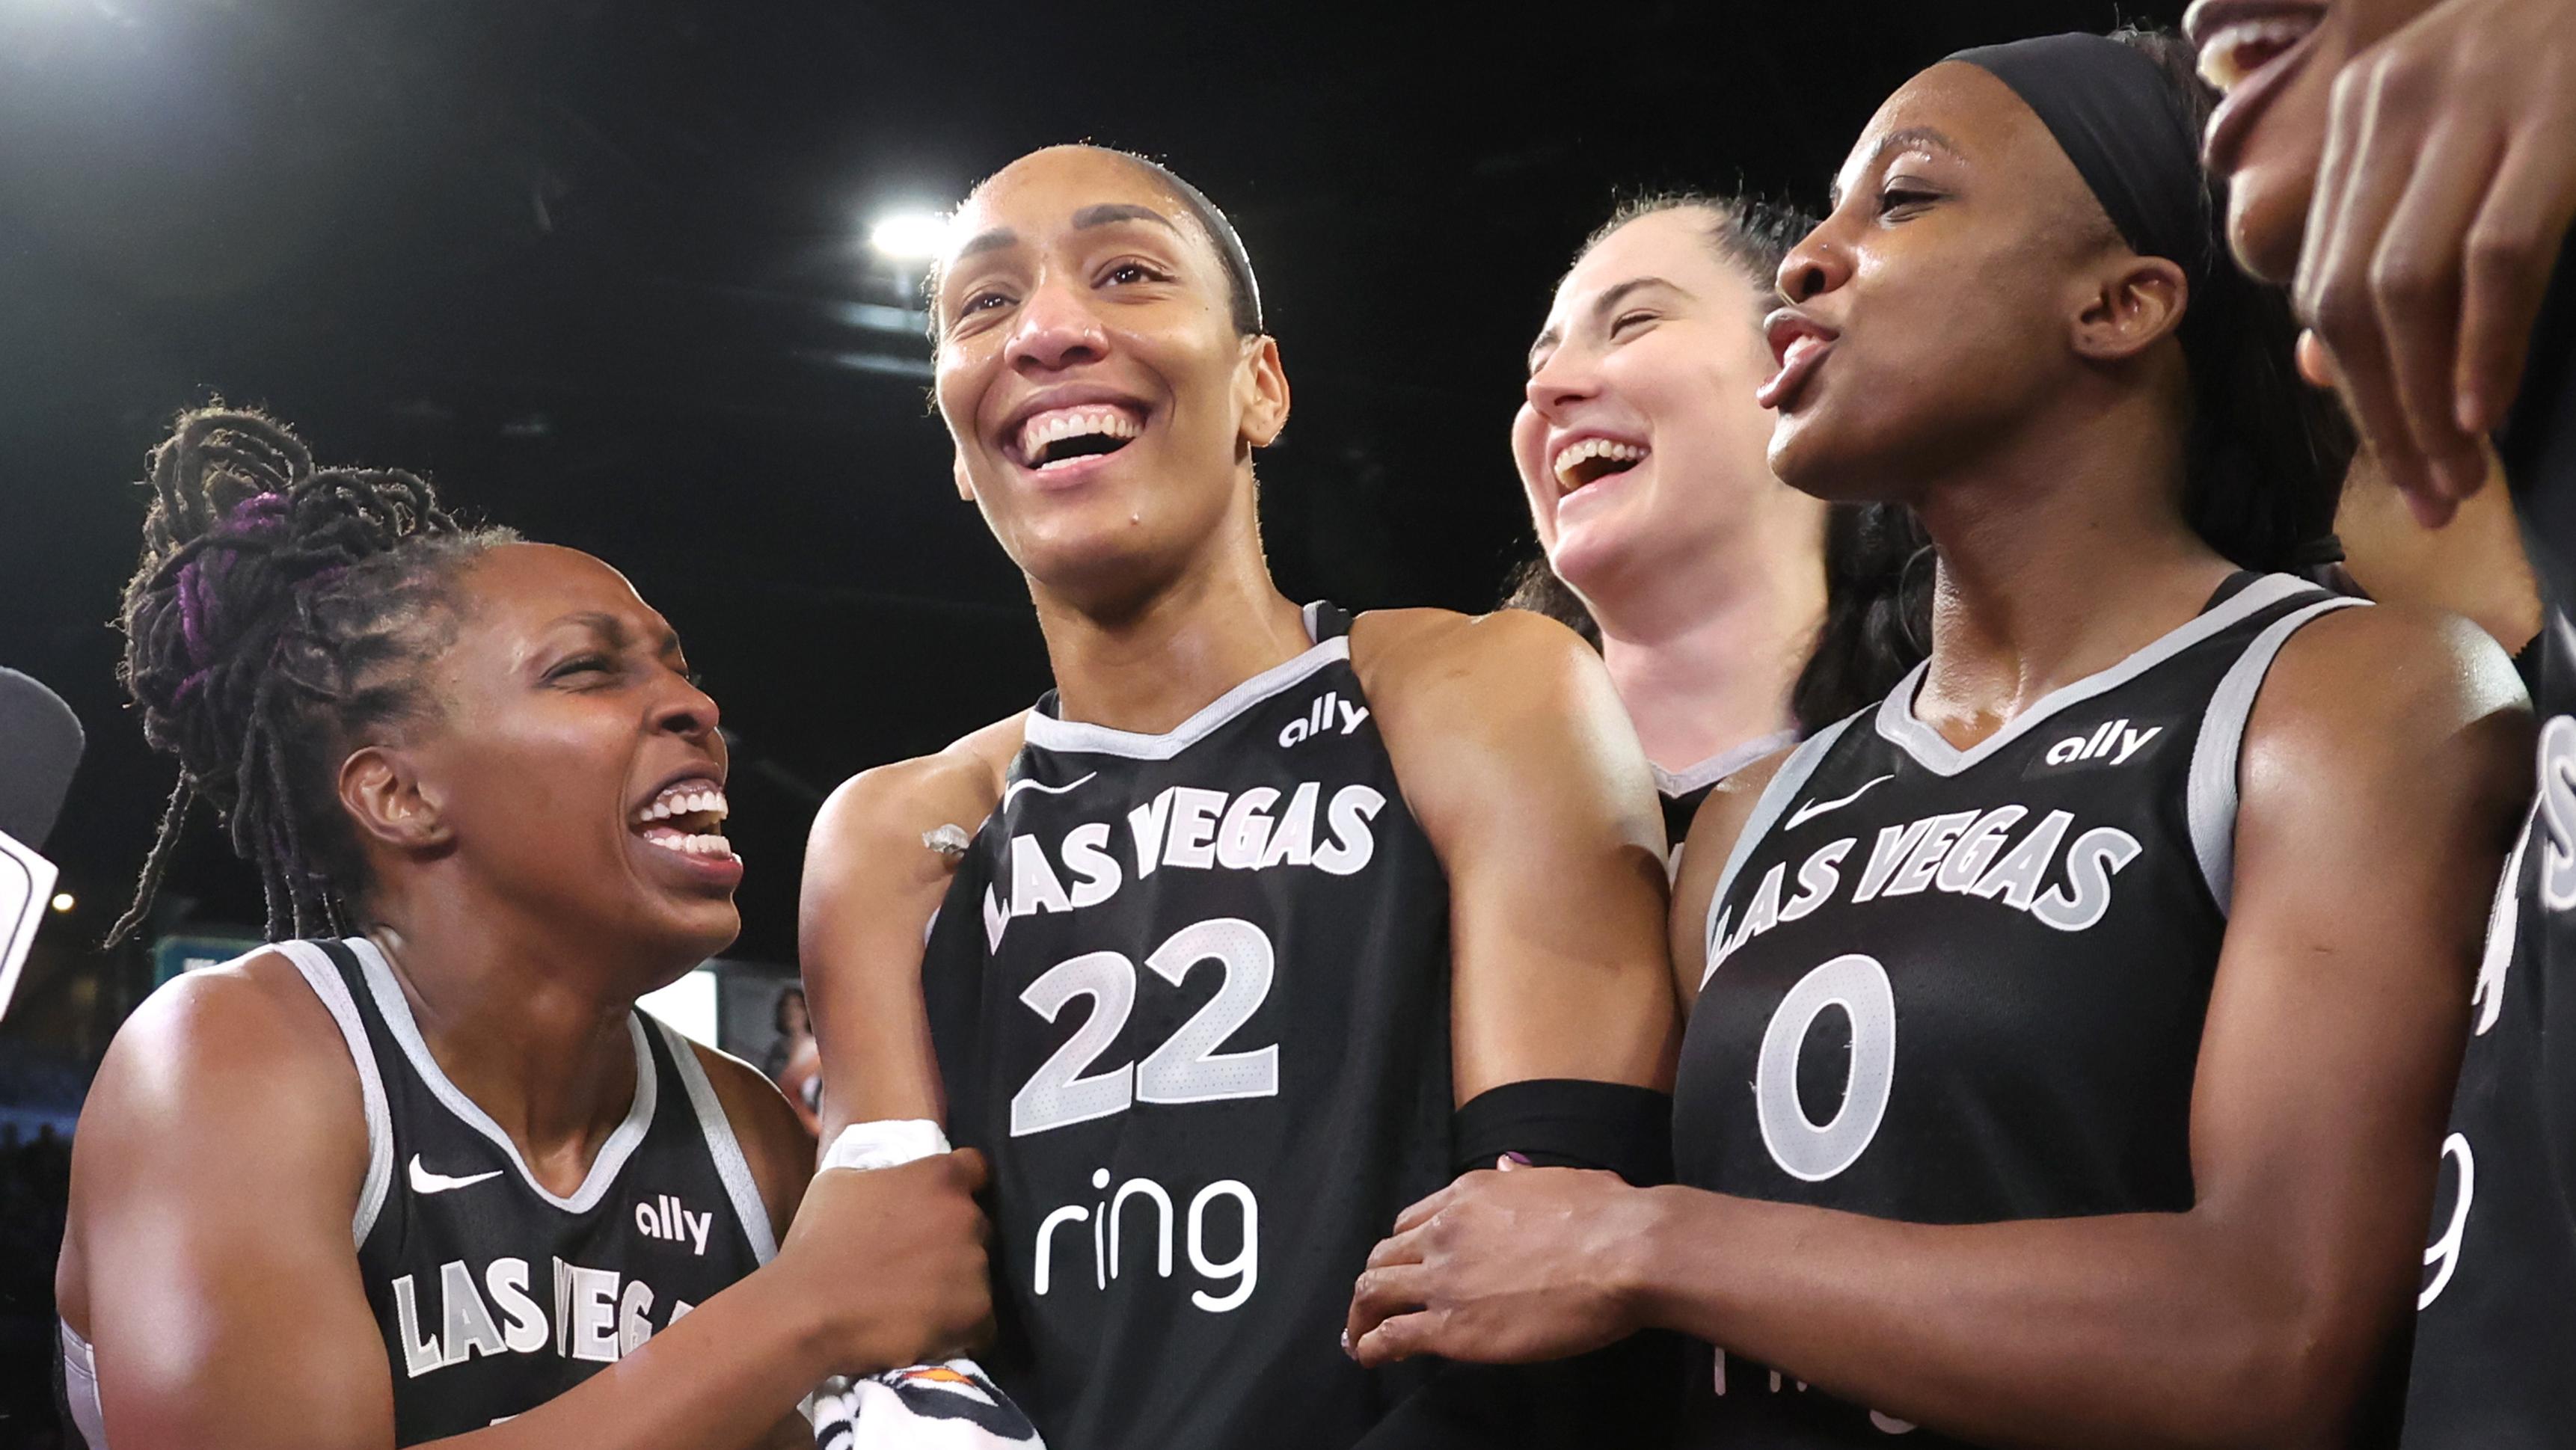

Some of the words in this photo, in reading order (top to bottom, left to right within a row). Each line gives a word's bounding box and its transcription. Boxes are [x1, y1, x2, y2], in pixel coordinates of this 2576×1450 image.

[1278, 691, 1370, 748] ally
[2045, 717, 2164, 767] ally
[1127, 781, 1387, 879] VEGAS
[1699, 837, 1857, 992] LAS
[1851, 804, 2143, 932] VEGAS
[1010, 917, 1279, 1137] 22
[1755, 953, 1897, 1182] 0
[635, 1194, 712, 1256] ally
[1034, 1167, 1259, 1313] ring
[391, 1256, 549, 1378] LAS
[551, 1256, 696, 1362] VEG
